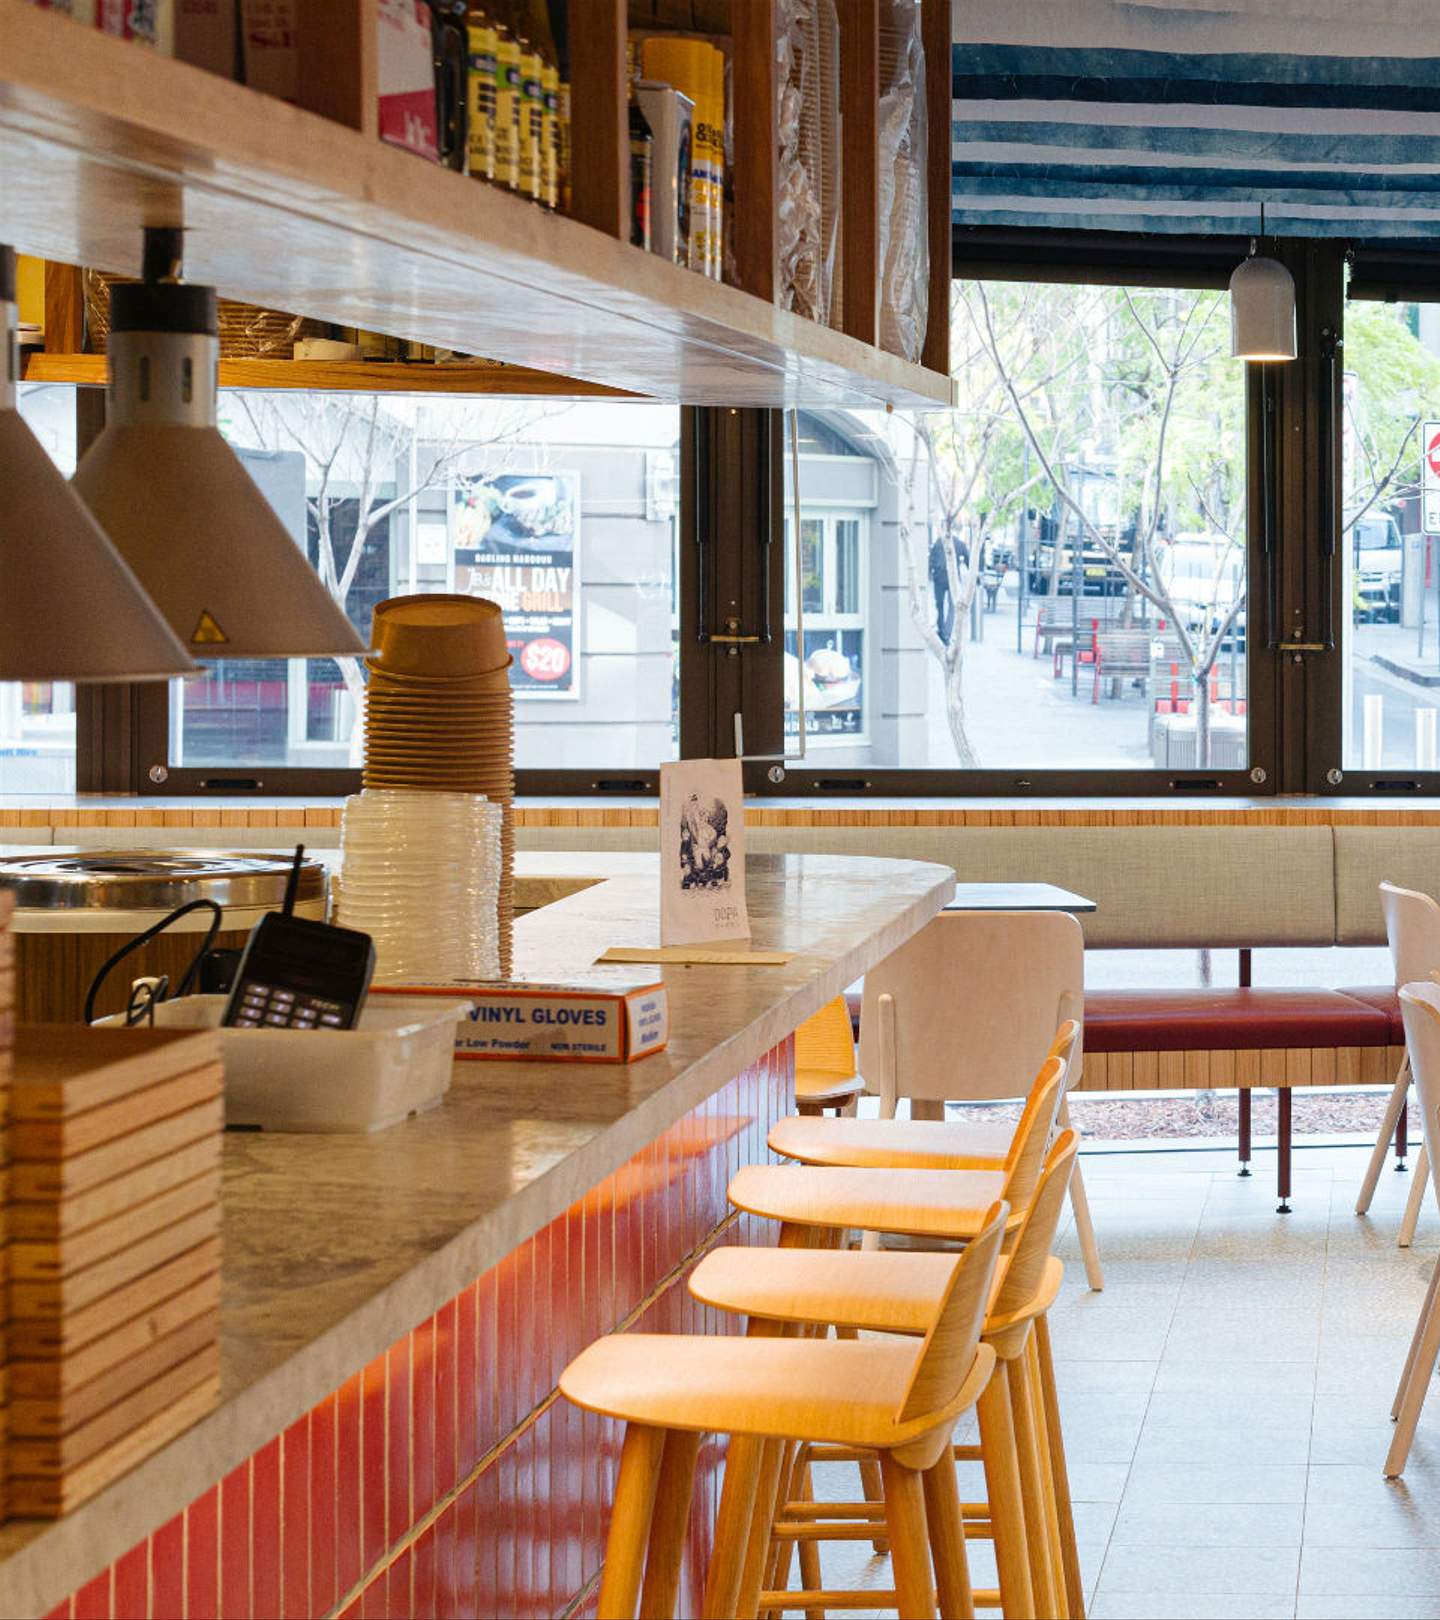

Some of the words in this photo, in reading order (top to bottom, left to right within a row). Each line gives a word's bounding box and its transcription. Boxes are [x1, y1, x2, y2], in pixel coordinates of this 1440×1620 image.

[491, 566, 528, 592] ALL
[531, 567, 571, 593] DAY
[526, 642, 565, 673] $20
[470, 1006, 525, 1024] VINYL
[532, 1007, 607, 1026] GLOVES
[466, 1038, 488, 1049] Low
[491, 1038, 531, 1050] Powder
